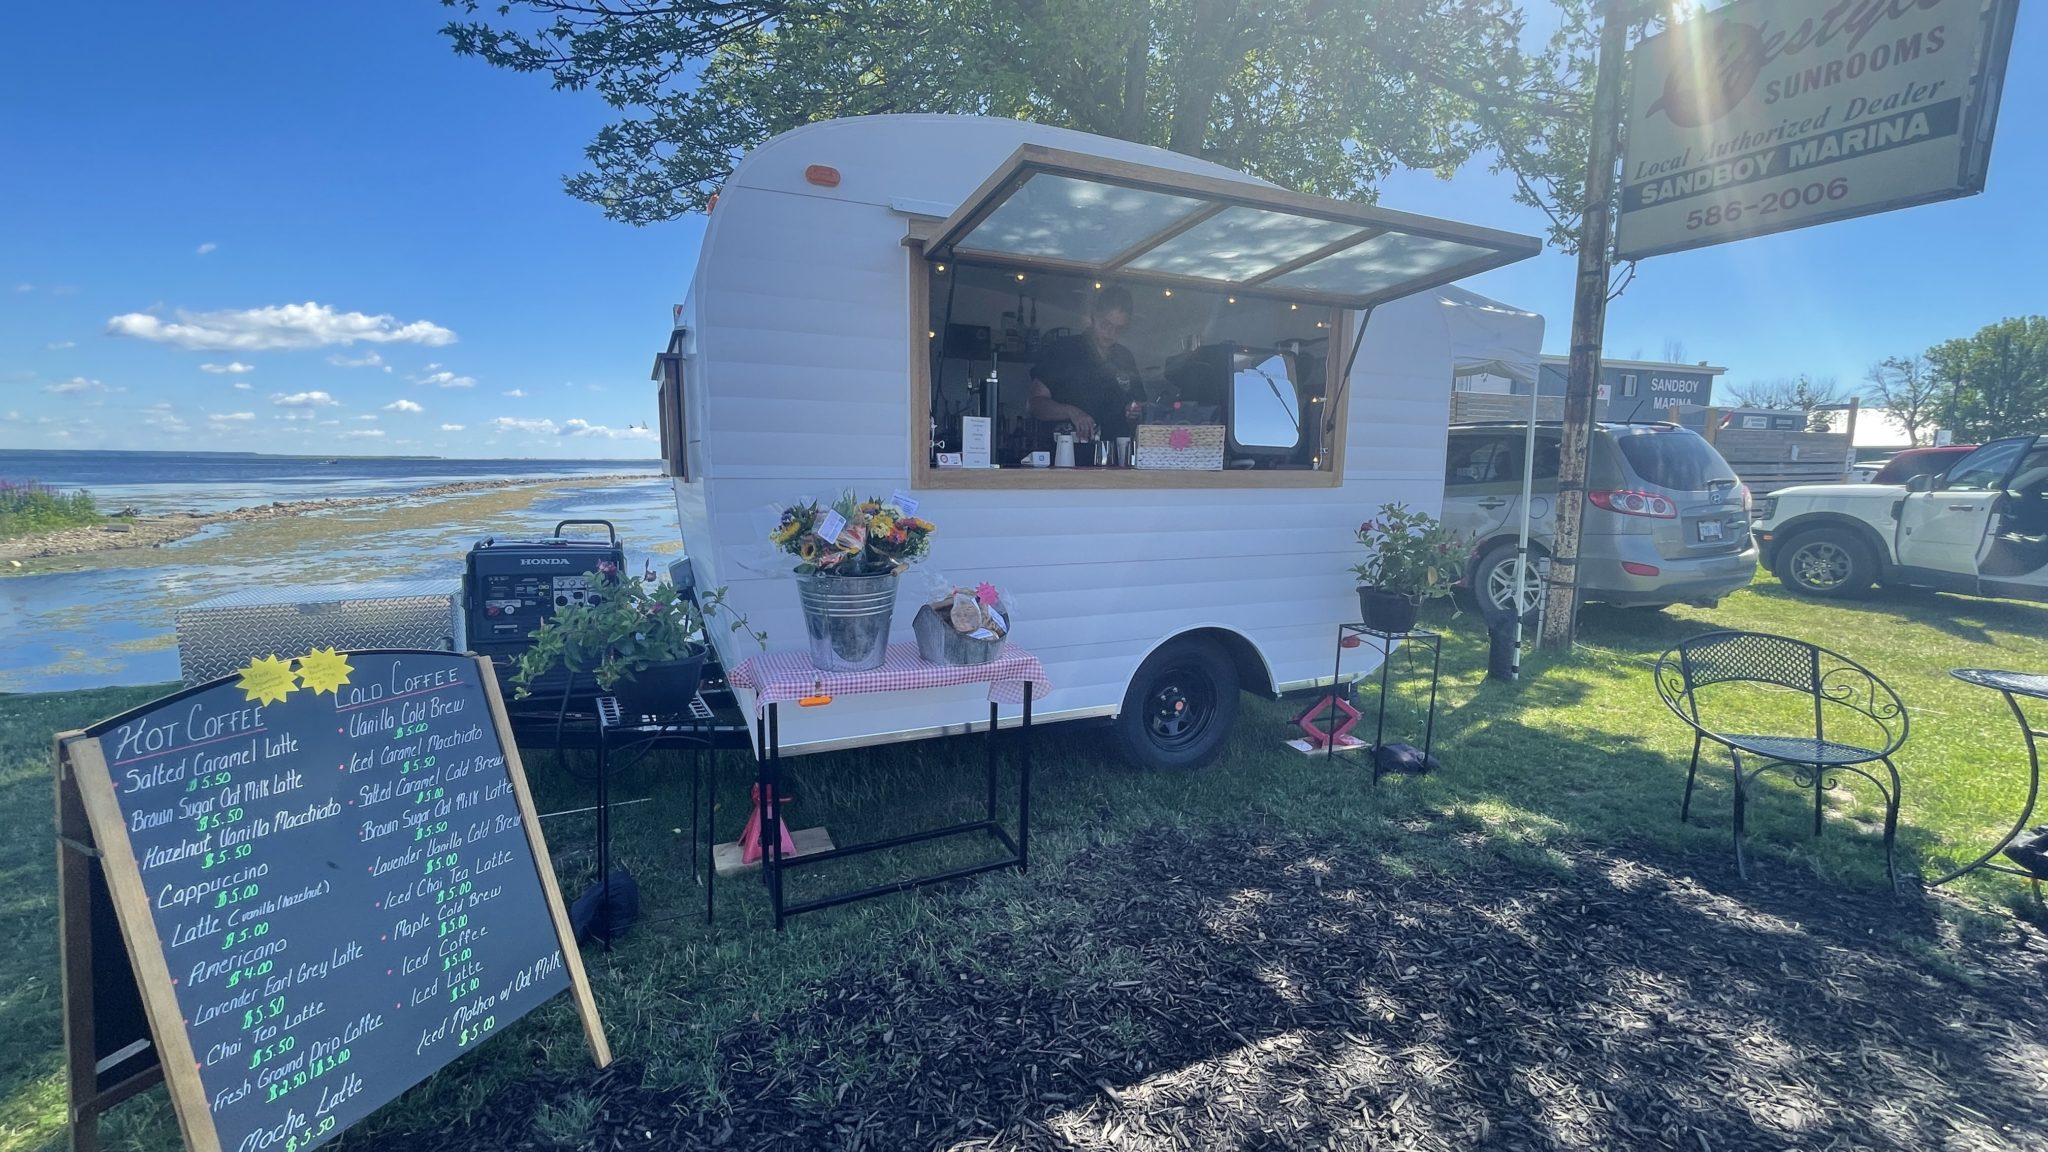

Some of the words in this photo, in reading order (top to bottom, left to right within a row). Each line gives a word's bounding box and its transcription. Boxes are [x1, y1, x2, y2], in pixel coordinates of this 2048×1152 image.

[1764, 25, 1945, 105] SUNROOMS
[1634, 147, 1688, 181] Local
[1843, 77, 1946, 122] Dealer
[1640, 150, 1777, 207] SANDBOY
[1788, 112, 1931, 169] MARINA
[1686, 177, 1849, 231] 586-2006
[1651, 378, 1699, 393] SANDBOY
[1653, 397, 1692, 410] MARINA
[520, 558, 570, 566] HONDA
[350, 707, 394, 738] Vanilla
[402, 702, 425, 725] Cold
[431, 696, 465, 718] Brew
[124, 758, 186, 794] Salted
[194, 739, 256, 776] Caramel
[266, 732, 299, 759] Latte
[350, 750, 374, 774] Iced
[381, 738, 422, 766] Caramel
[428, 723, 483, 751] Macchiato
[132, 808, 173, 832] Brown
[179, 795, 215, 822] Sugar
[220, 787, 241, 807] Oat
[245, 779, 269, 802] Milk
[273, 771, 304, 795] Latte
[358, 781, 392, 808] Salted
[396, 767, 440, 797] Caramel
[446, 760, 470, 782] Cold
[475, 754, 504, 772] Brew
[361, 819, 398, 842] Brown
[403, 809, 429, 830] Sugar
[435, 798, 451, 817] Oat
[456, 790, 479, 811] Milk
[486, 778, 513, 801] Latte
[143, 833, 212, 870] Hazelnut
[220, 816, 269, 846] Vanilla
[274, 797, 341, 833] Macchiato
[373, 846, 423, 877] Lavender
[468, 819, 489, 843] Cold
[495, 813, 522, 835] Brew
[158, 863, 268, 909] Cappuccino
[384, 883, 412, 910] Iced
[417, 877, 443, 896] Chai
[450, 865, 469, 885] Tea
[476, 850, 514, 874] Latte
[171, 914, 221, 947] Latte
[394, 913, 432, 941] Maple
[438, 900, 463, 921] Cold
[469, 885, 502, 906] Brew
[188, 938, 287, 987] Americano
[402, 947, 431, 976] Iced
[439, 926, 489, 958] Coffee
[194, 988, 259, 1027] Lavender
[264, 968, 293, 998] Earl
[297, 961, 328, 985] Grey
[333, 941, 363, 969] Latte
[411, 978, 438, 1007] Iced
[447, 961, 484, 988] Latte
[417, 1017, 449, 1056] Iced
[516, 966, 532, 992] Oat
[535, 950, 561, 982] Milk
[207, 1038, 242, 1066] Chai
[252, 1026, 277, 1044] Tea
[284, 1001, 326, 1031] Latte
[213, 1079, 252, 1112] Fresh
[258, 1050, 305, 1089] Ground
[344, 1013, 384, 1045] Coffee
[238, 1108, 306, 1152] Mocha
[315, 1072, 363, 1118] Latte
